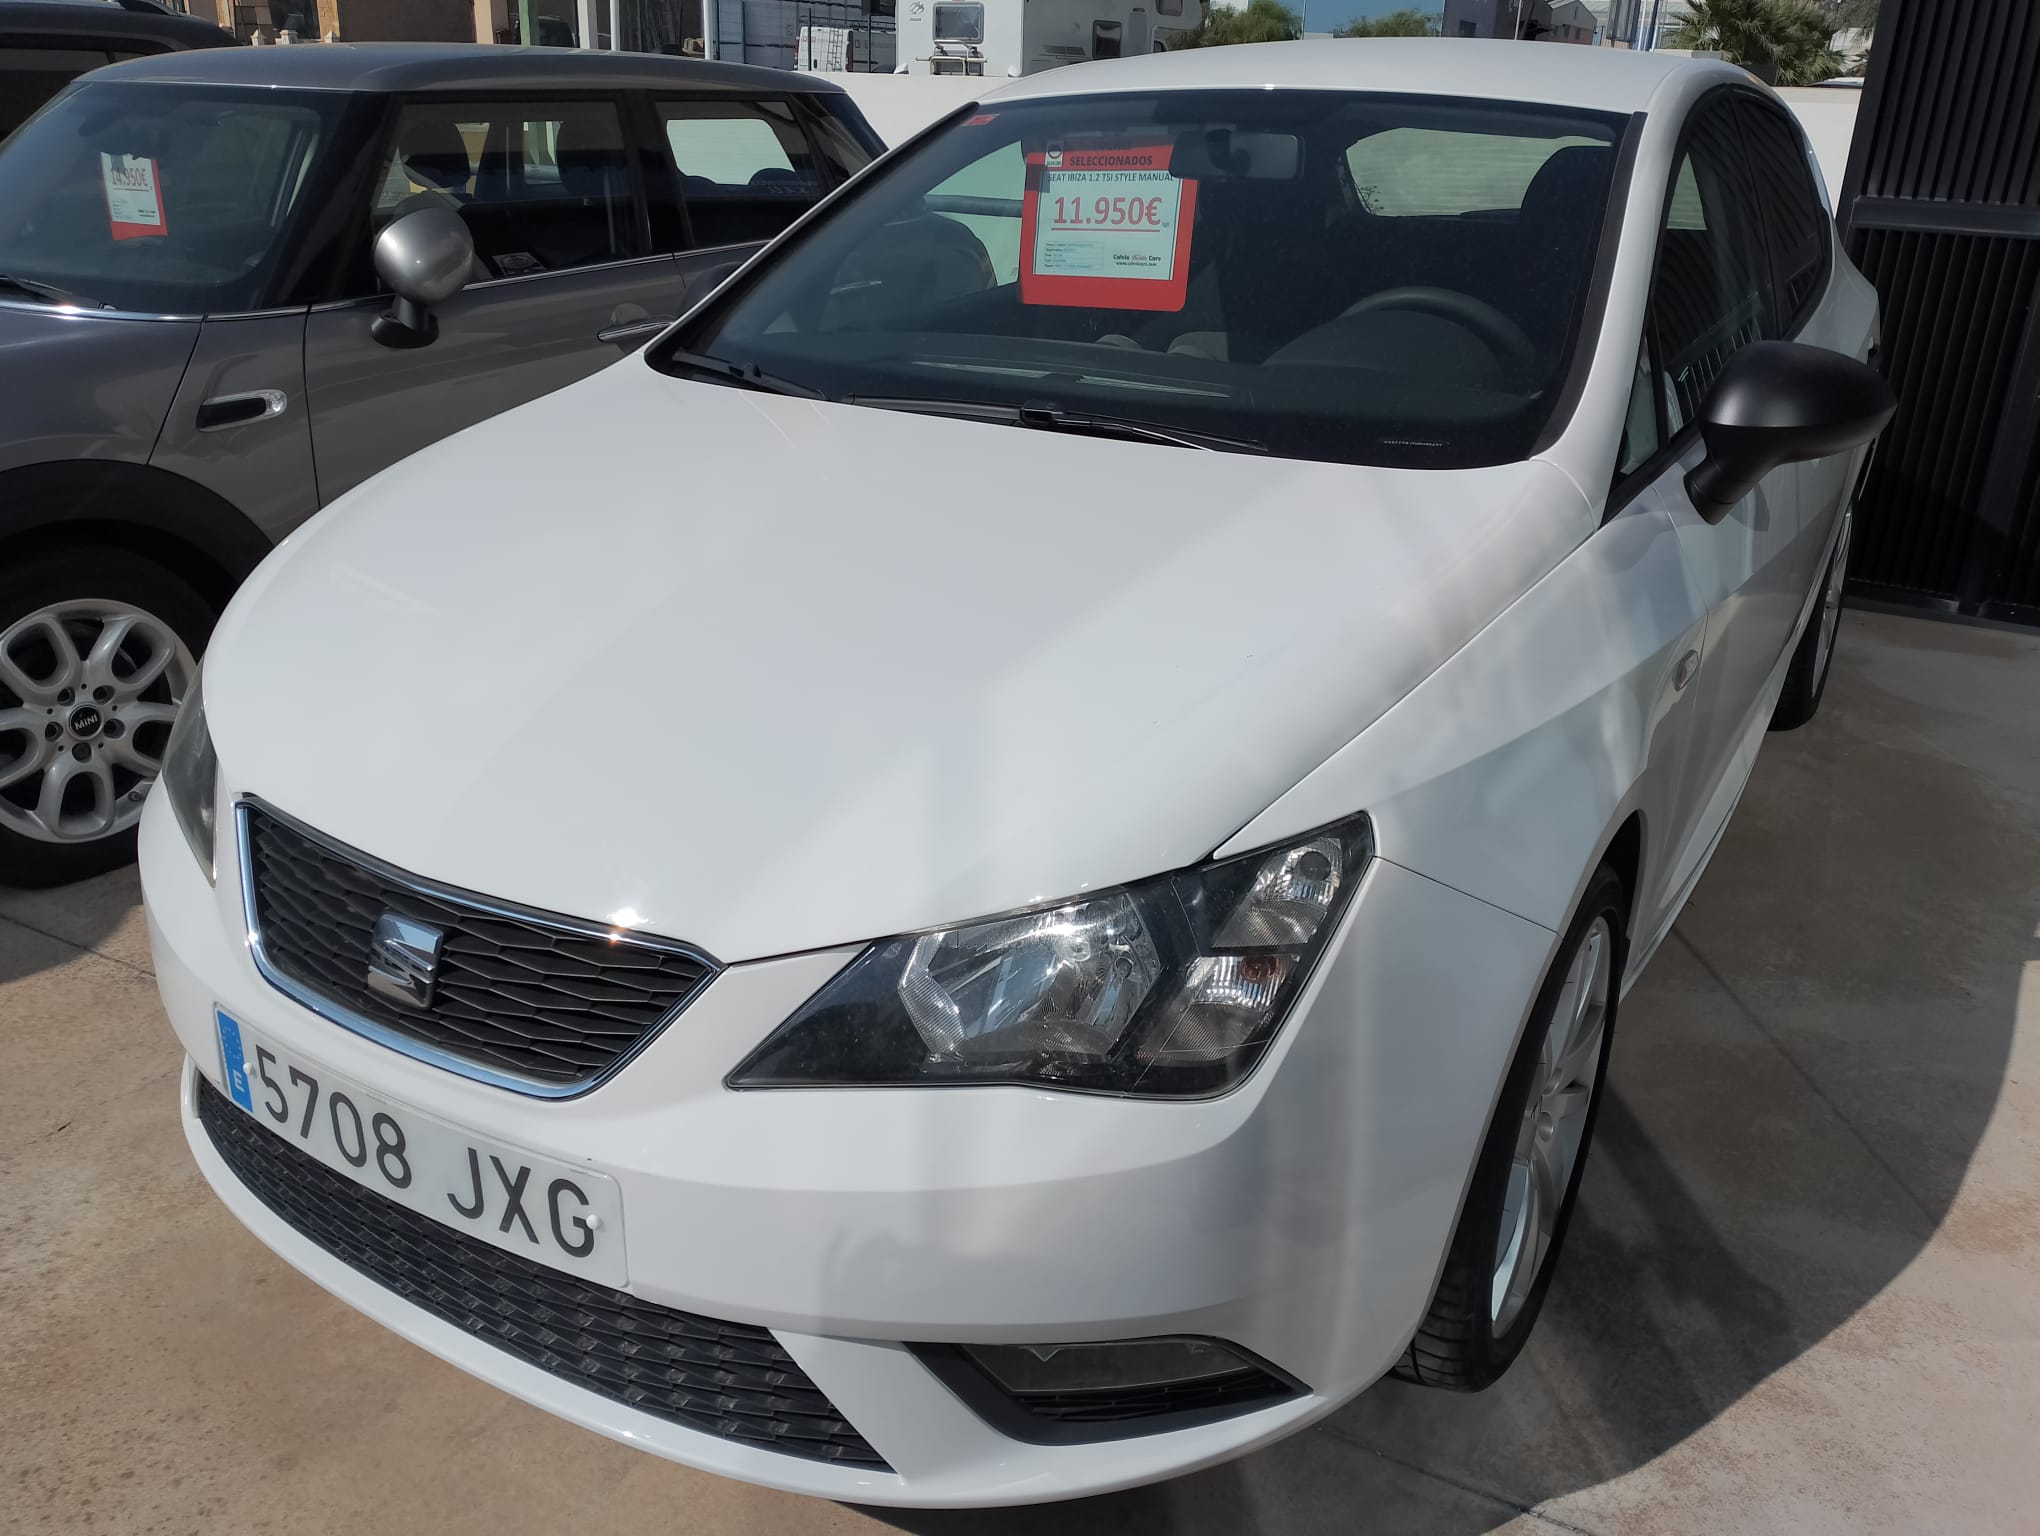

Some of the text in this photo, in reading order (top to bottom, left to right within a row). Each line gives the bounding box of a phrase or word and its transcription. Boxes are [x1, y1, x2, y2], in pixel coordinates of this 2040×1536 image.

[1070, 155, 1153, 167] SELECCIONADOS
[1047, 172, 1174, 182] SEAT IBIZA 1.2 TSI STYLE MANUAL
[1053, 196, 1163, 226] 11.950€
[74, 713, 98, 730] MINI
[232, 1068, 246, 1093] E
[255, 1043, 596, 1259] 5708 JXG
